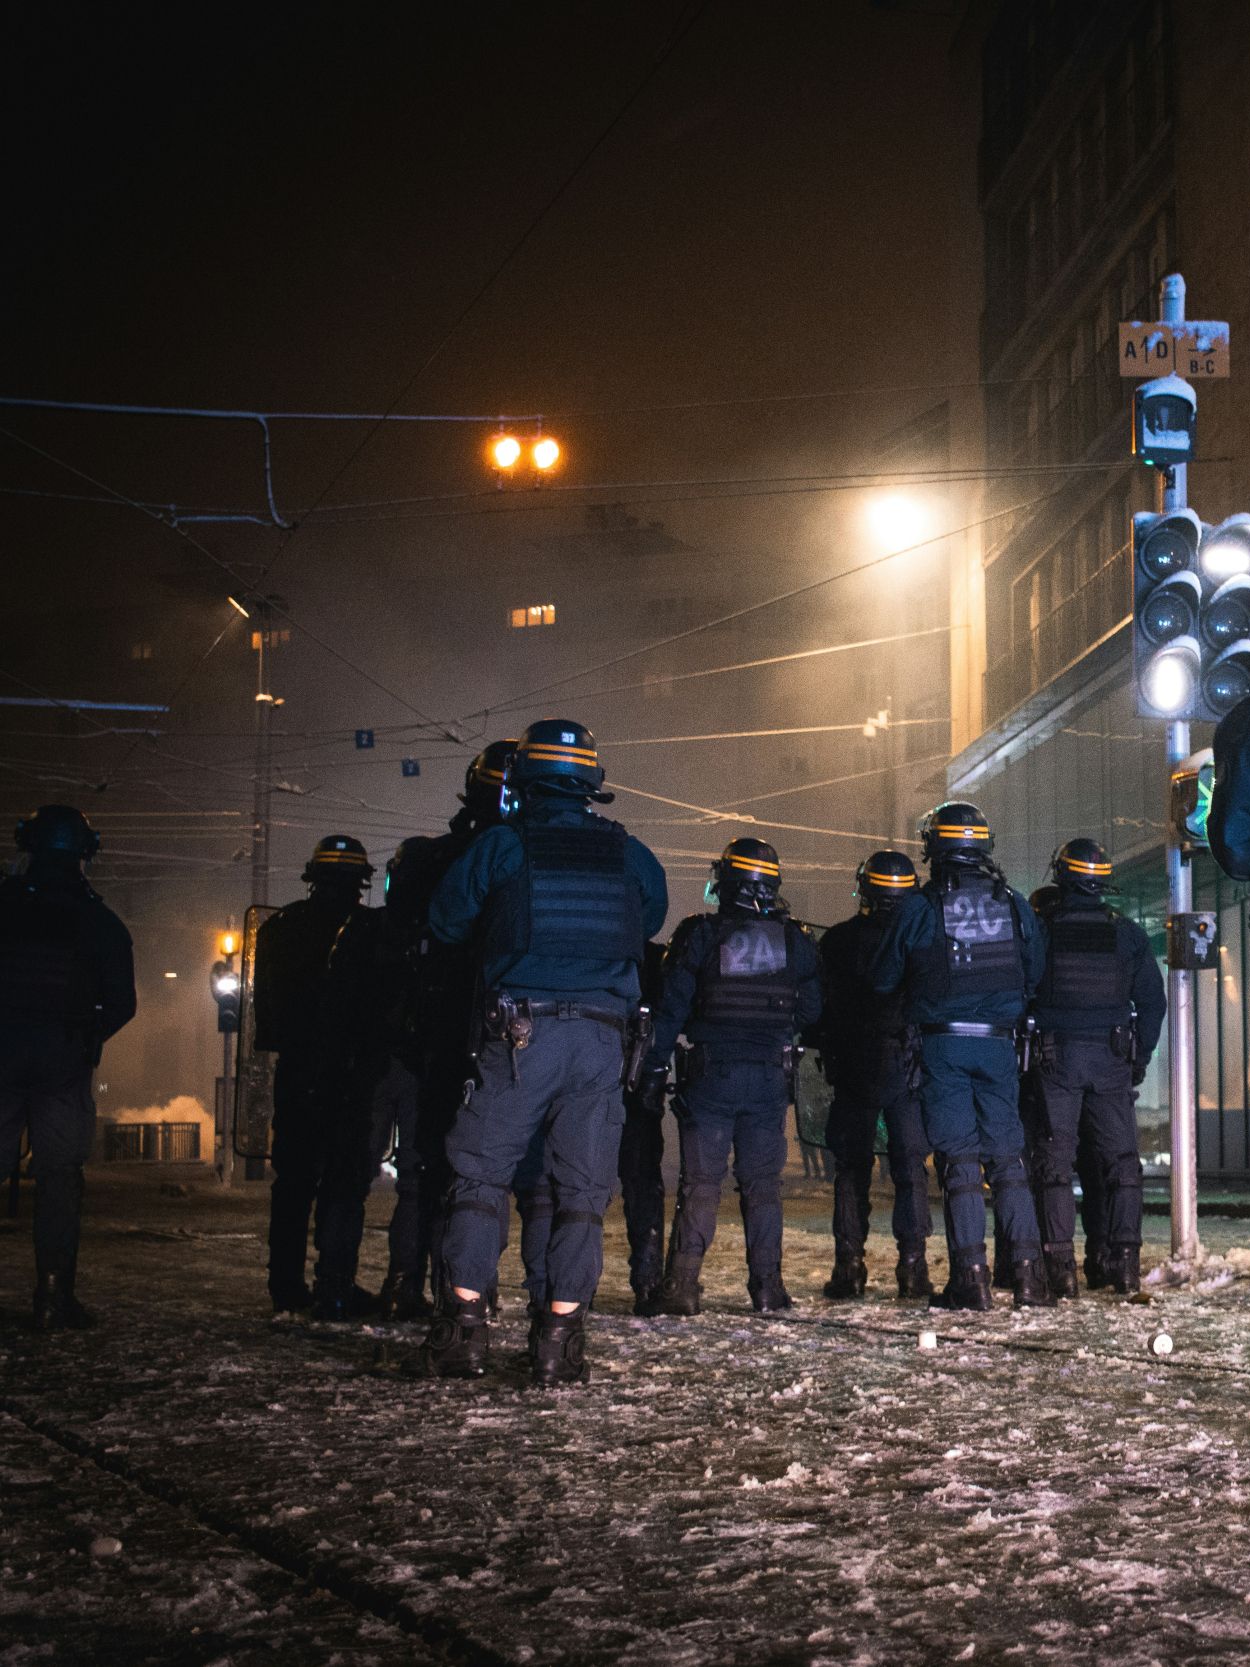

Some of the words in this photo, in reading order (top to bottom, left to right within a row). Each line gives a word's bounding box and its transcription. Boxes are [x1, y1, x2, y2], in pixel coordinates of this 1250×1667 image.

[1125, 341, 1137, 358] A
[1156, 341, 1168, 358] D
[1190, 360, 1215, 374] B-C
[729, 929, 777, 972] 2A
